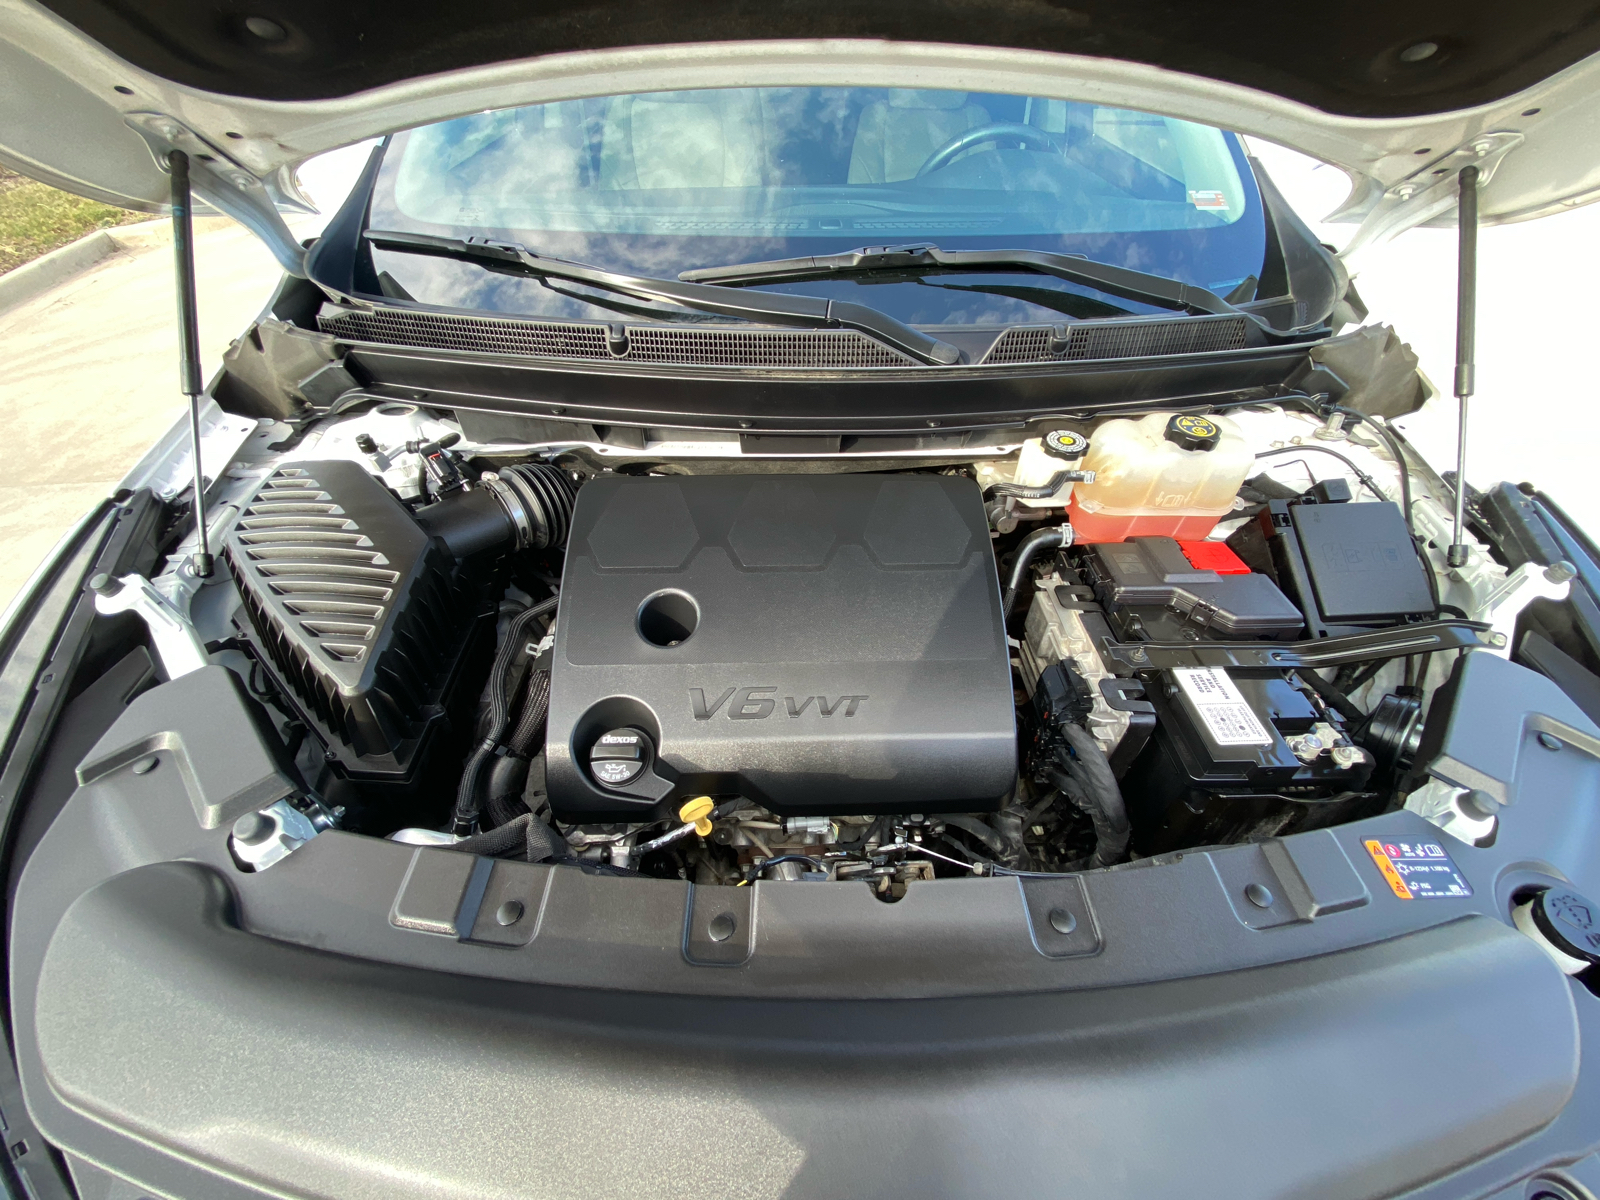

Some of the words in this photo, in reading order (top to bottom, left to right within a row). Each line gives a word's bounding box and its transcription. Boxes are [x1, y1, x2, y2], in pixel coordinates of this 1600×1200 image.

[1189, 674, 1205, 693] RECORD
[1196, 674, 1212, 693] SERVICE
[1205, 678, 1216, 689] AND
[689, 686, 778, 721] V6
[784, 695, 870, 718] VVT
[602, 735, 638, 744] dexos
[600, 771, 611, 780] SAE
[611, 770, 631, 780] 5W-30
